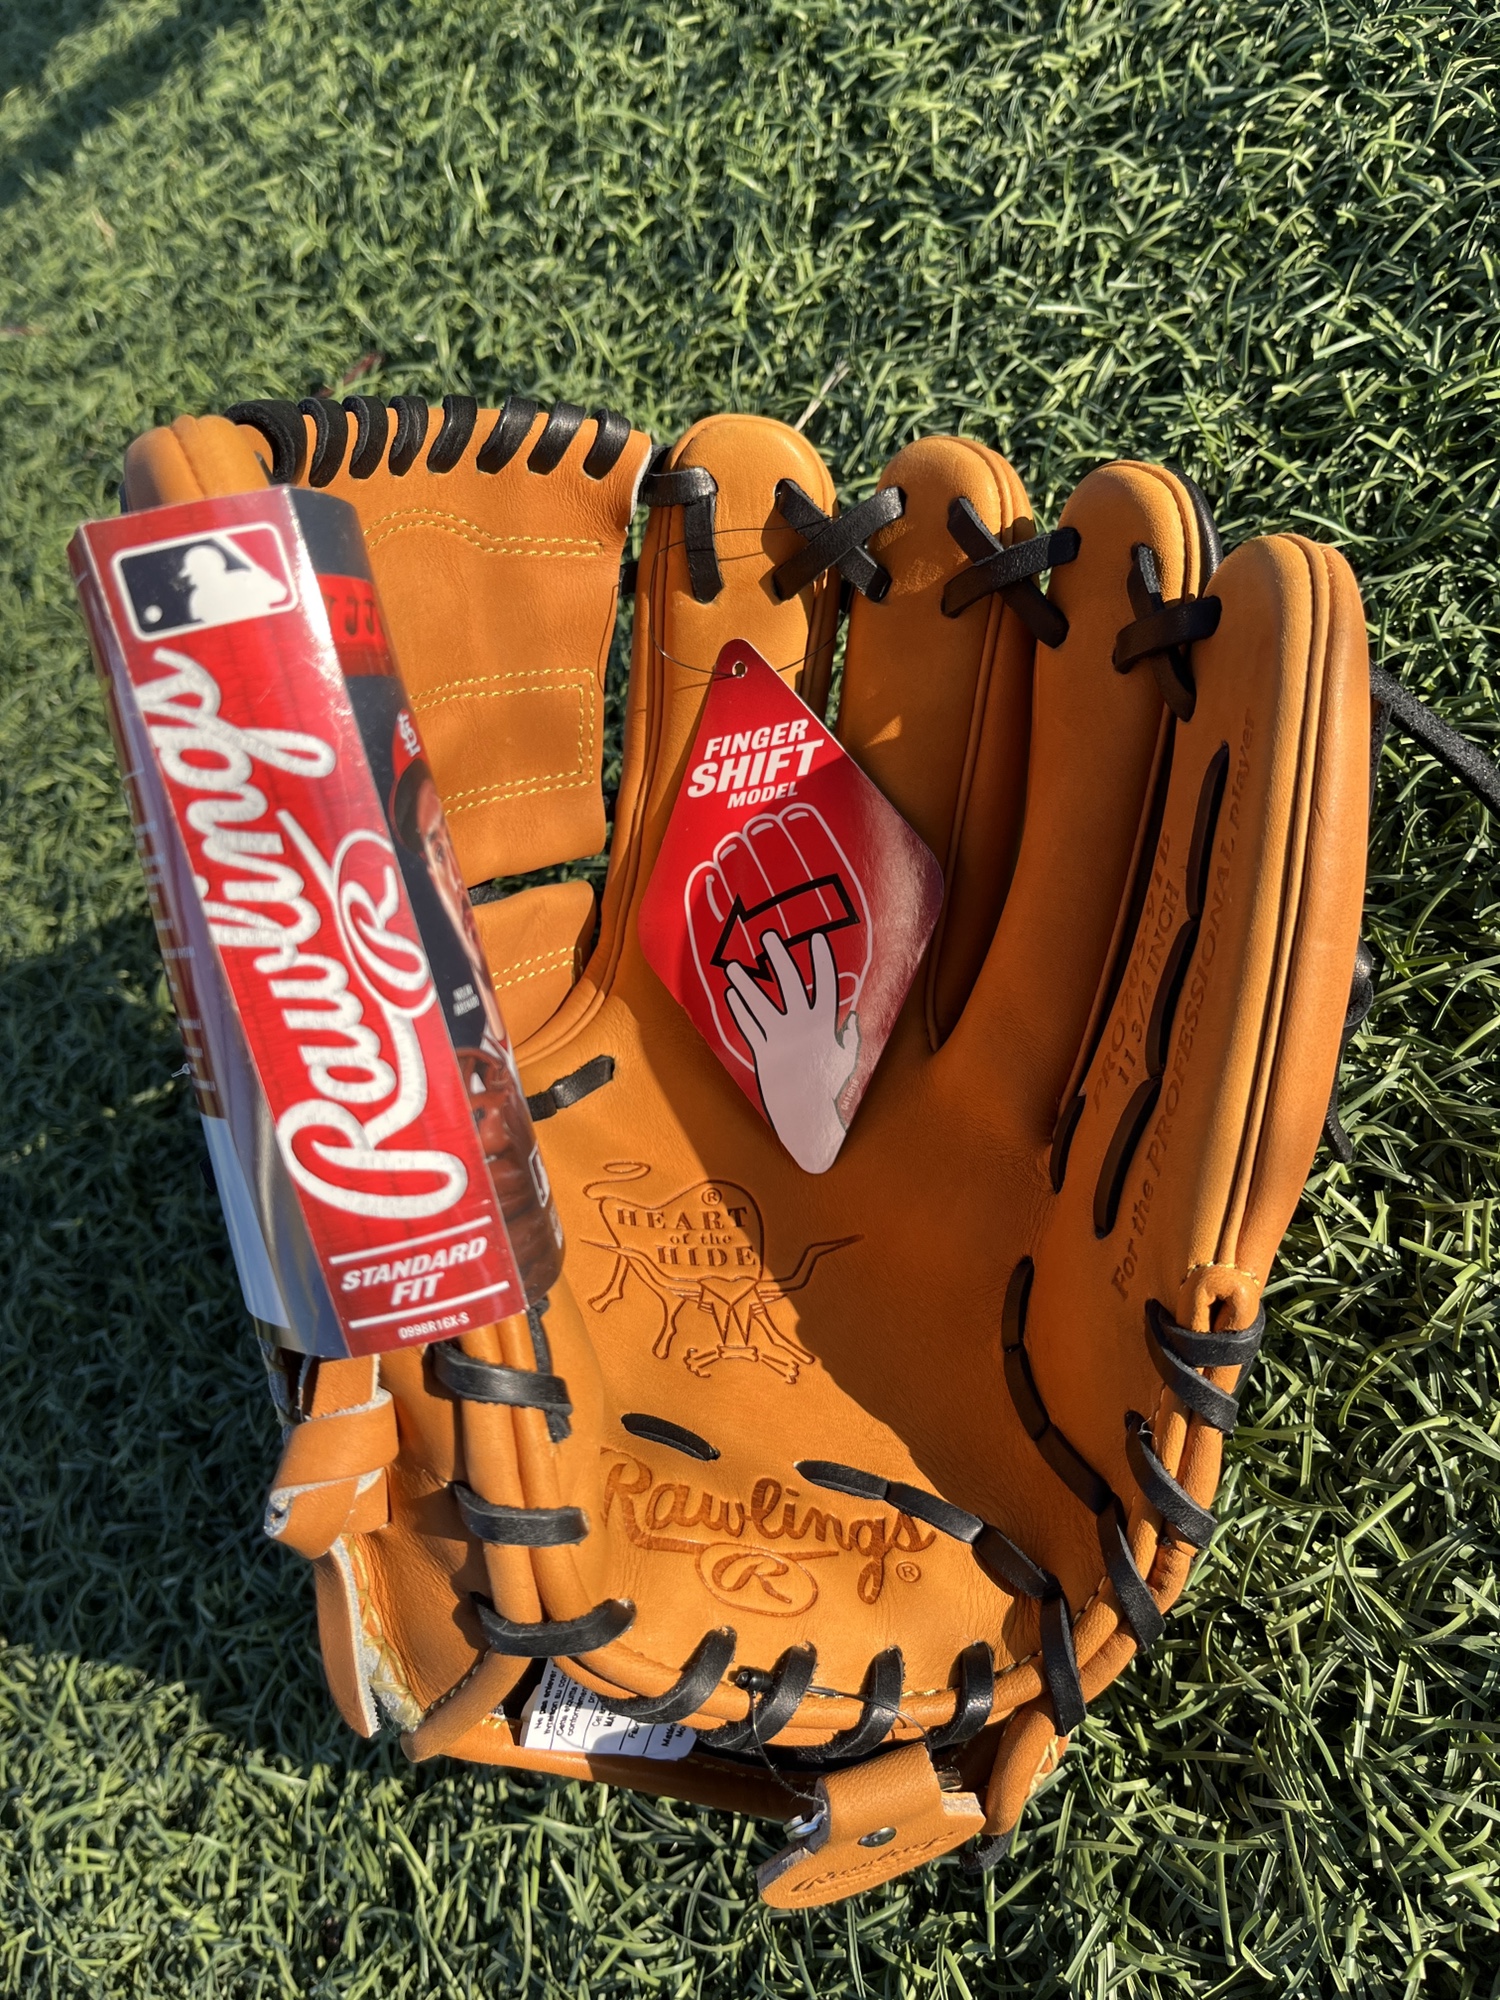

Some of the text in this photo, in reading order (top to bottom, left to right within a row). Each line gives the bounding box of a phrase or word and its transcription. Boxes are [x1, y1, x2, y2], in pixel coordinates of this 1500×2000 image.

[703, 718, 809, 760] FINGER
[687, 739, 825, 798] SHIFT
[727, 781, 798, 809] MODEL
[136, 648, 468, 1219] Rawlings
[1147, 878, 1180, 975] INCH
[1111, 1239, 1138, 1301] For
[1132, 1178, 1154, 1235] the
[1146, 838, 1236, 1177] PROFESSIONAL
[616, 1206, 748, 1231] HEART
[670, 1231, 732, 1245] of the
[341, 1236, 488, 1292] STANDARD
[656, 1245, 757, 1267] HIDE
[390, 1272, 445, 1306] FIT
[600, 1447, 937, 1605] Rawlings
